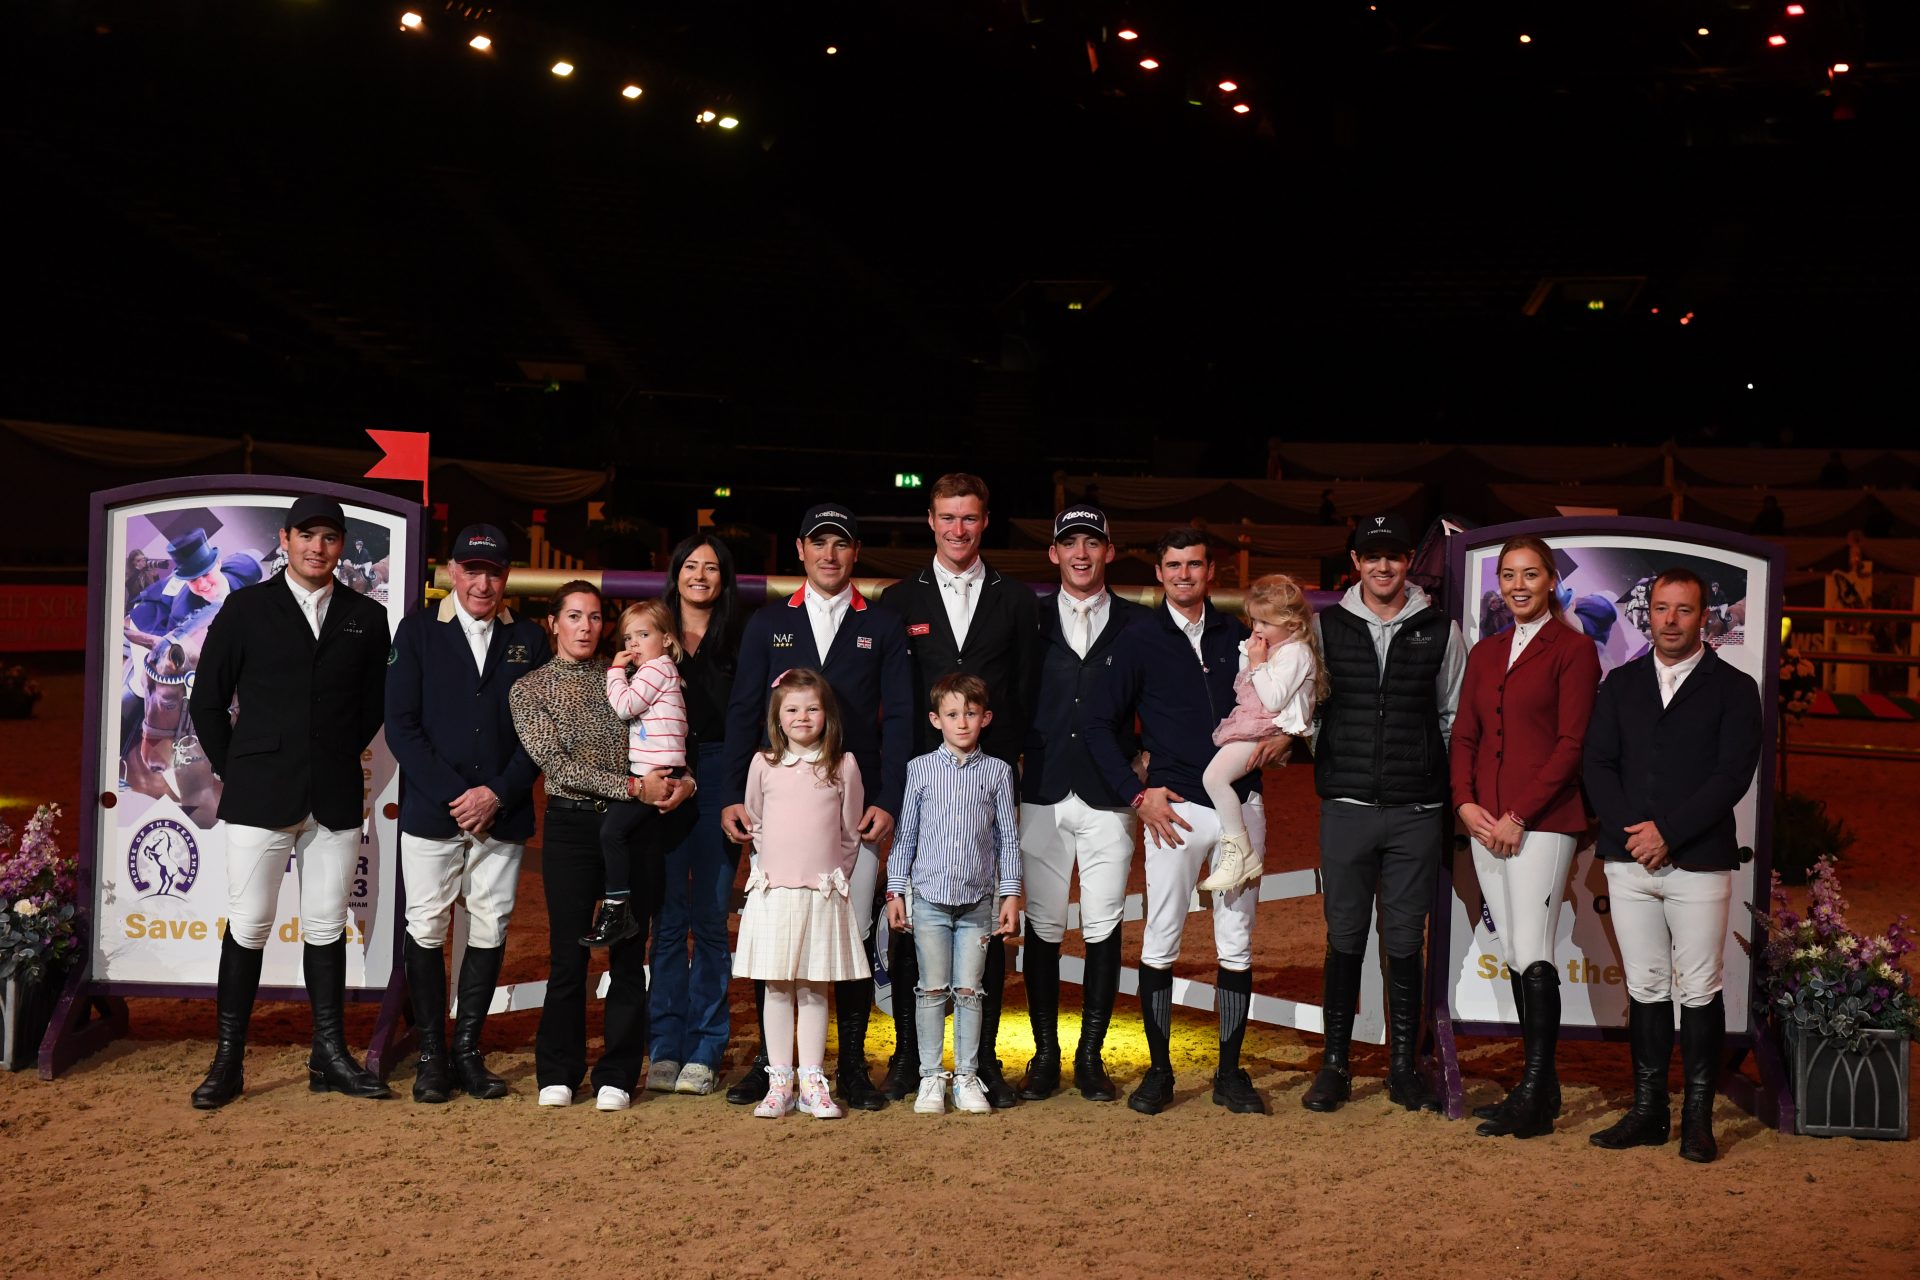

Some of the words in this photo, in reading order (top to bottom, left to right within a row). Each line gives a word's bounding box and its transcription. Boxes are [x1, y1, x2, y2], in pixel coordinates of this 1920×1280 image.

[773, 633, 794, 643] NAF
[130, 848, 140, 884] HORSE
[135, 831, 146, 843] OF
[149, 821, 170, 830] THE
[176, 824, 195, 849] YEAR
[187, 853, 197, 885] SHOW
[125, 914, 207, 940] Save
[1567, 958, 1622, 985] the
